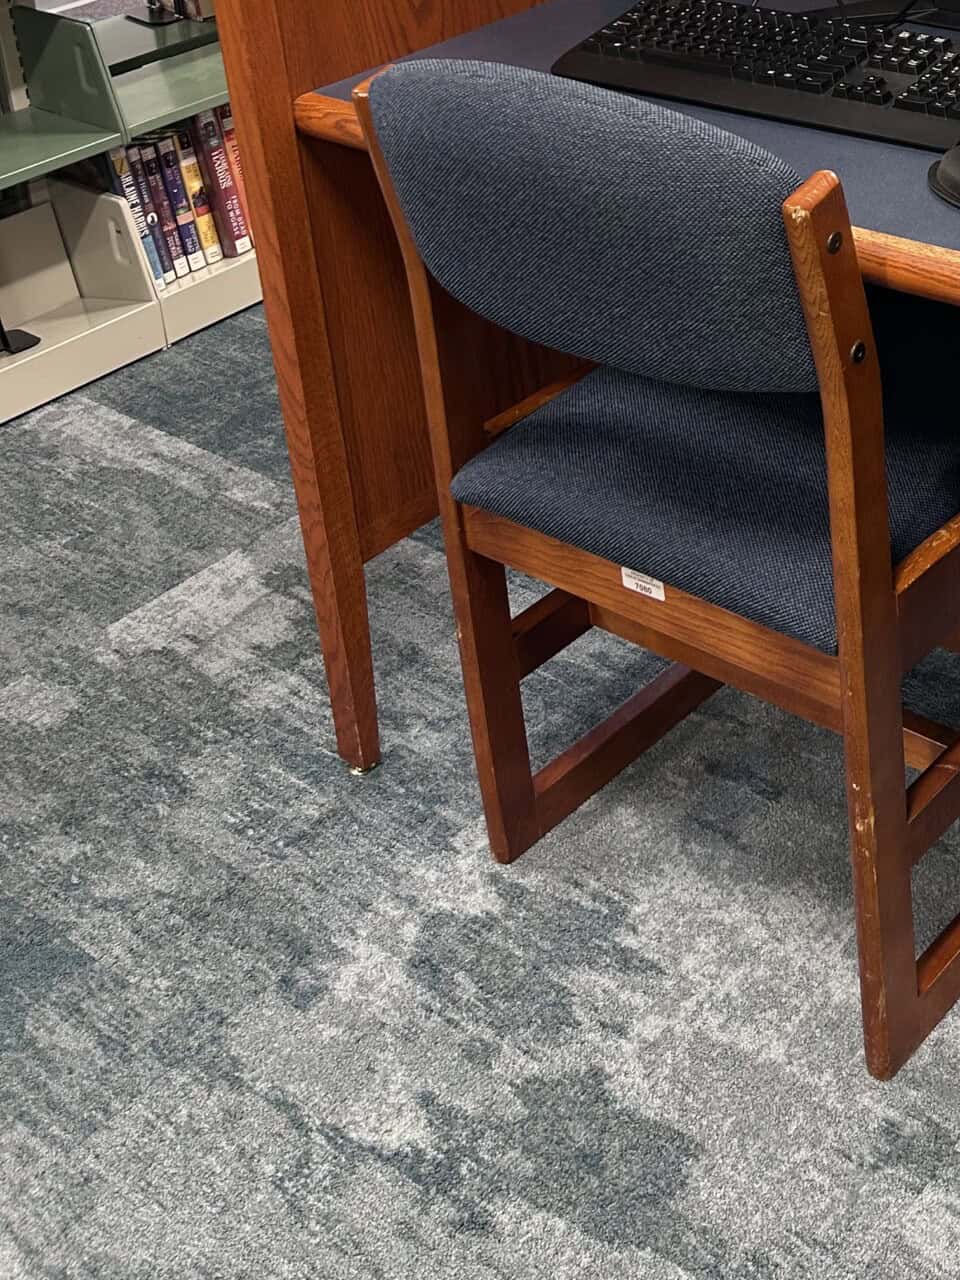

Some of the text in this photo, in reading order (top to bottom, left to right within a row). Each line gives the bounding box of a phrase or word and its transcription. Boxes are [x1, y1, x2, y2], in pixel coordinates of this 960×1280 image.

[212, 151, 227, 190] HARRIS
[131, 206, 148, 238] HARRIS
[225, 200, 239, 236] TO WORSE
[231, 196, 246, 236] FROM DEAD
